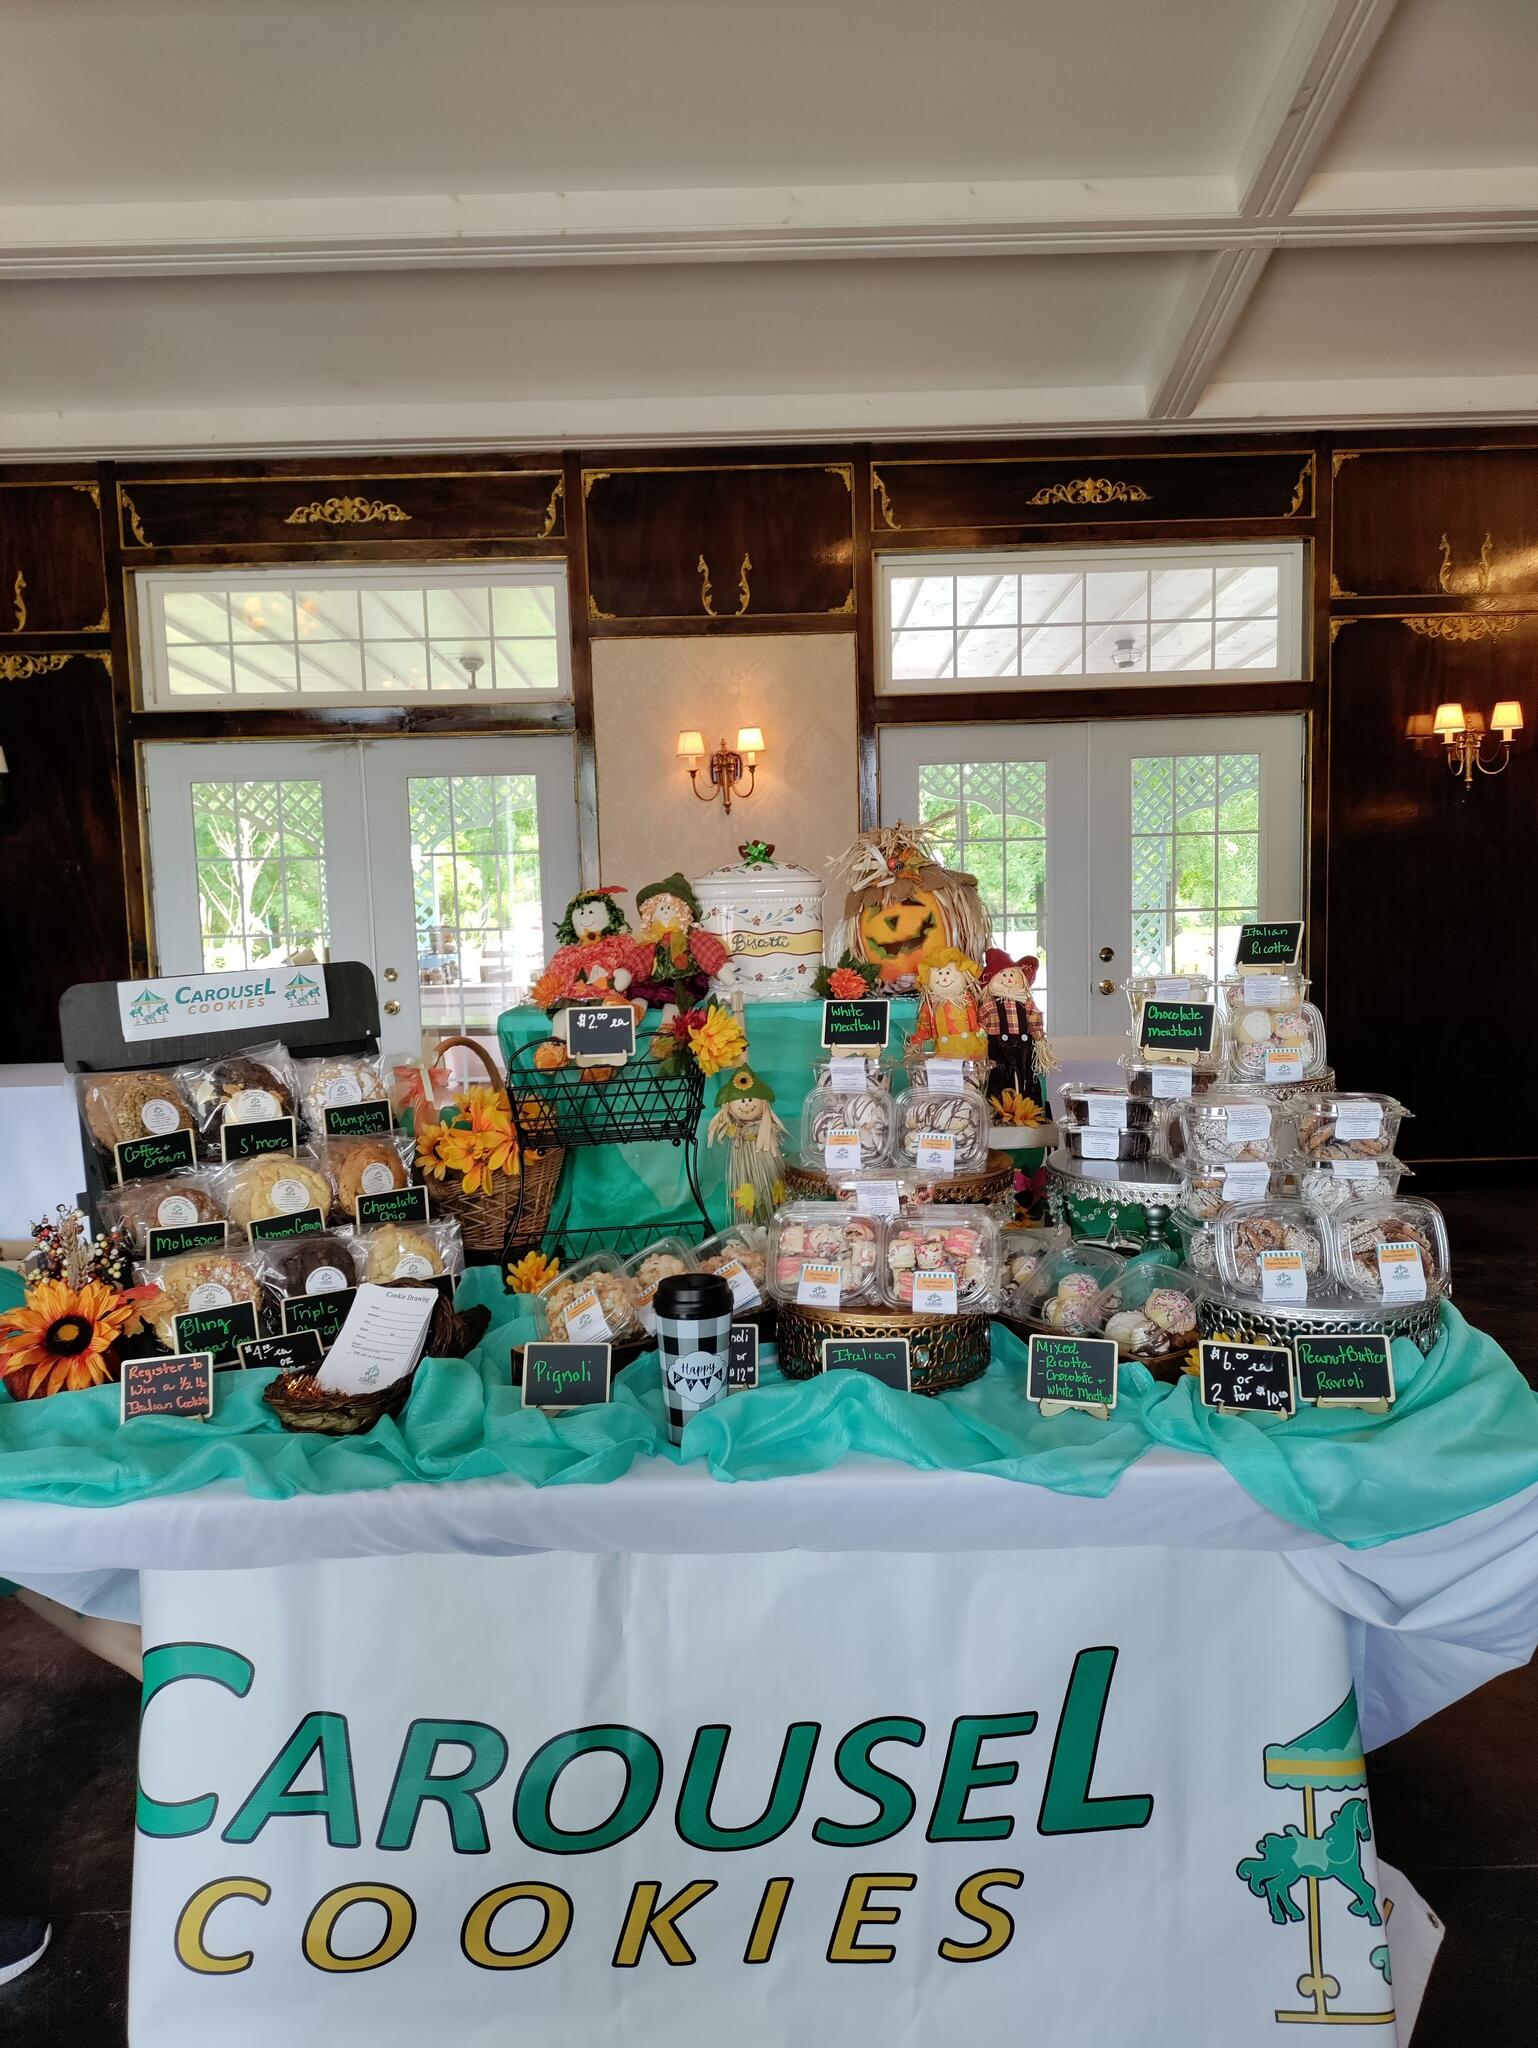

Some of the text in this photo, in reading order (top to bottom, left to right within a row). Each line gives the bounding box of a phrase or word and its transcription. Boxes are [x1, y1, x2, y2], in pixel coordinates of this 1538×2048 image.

[1241, 927, 1288, 938] Italian
[732, 934, 790, 953] Biscotti
[1251, 942, 1294, 955] Ricotta
[187, 997, 266, 1015] COOKIES
[1147, 1005, 1203, 1021] Chocolate
[330, 1111, 385, 1128] Pumpkin
[124, 1144, 162, 1163] Coffee
[239, 1135, 289, 1154] S'more
[362, 1192, 418, 1215] Chocolate
[255, 1225, 295, 1241] Lemon
[286, 1301, 338, 1321] Triple
[179, 1317, 232, 1338] Bling
[832, 1347, 896, 1363] Italian
[1036, 1341, 1079, 1355] Mixed
[1299, 1343, 1386, 1365] Peanut Butter
[128, 1358, 203, 1384] Register to
[533, 1360, 592, 1394] Pignoli
[681, 1363, 716, 1377] Happy
[1316, 1367, 1364, 1390] Ravioli
[1237, 1376, 1253, 1384] or
[130, 1385, 156, 1396] Win
[1211, 1383, 1225, 1403] 2
[126, 1398, 173, 1415] Italian
[174, 1867, 1025, 1974] COOKIES
